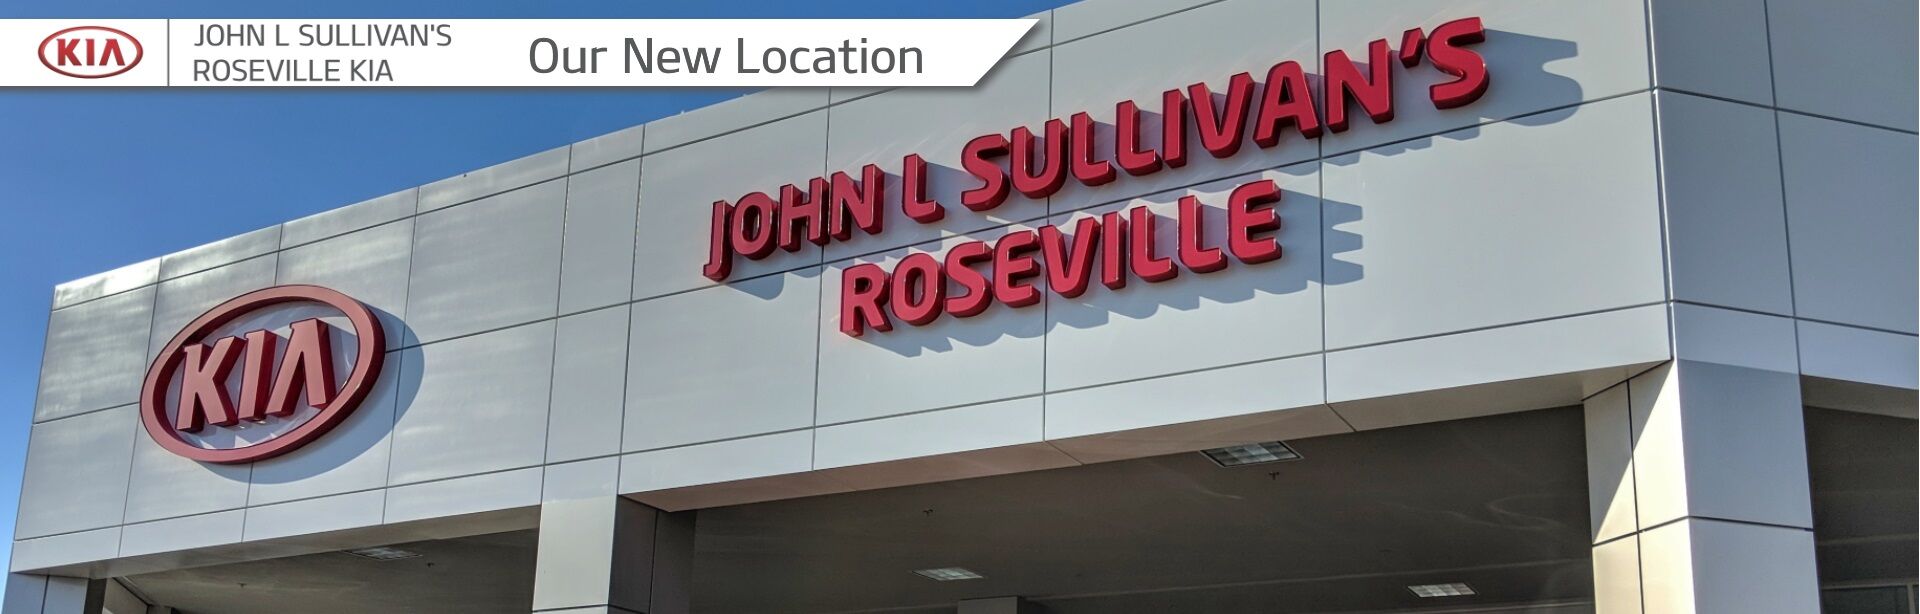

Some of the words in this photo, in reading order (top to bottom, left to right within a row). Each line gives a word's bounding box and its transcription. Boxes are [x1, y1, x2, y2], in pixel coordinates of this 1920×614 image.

[703, 163, 886, 282] JOHN
[902, 153, 945, 224] L
[961, 16, 1490, 212] SULLIVAN'S
[839, 179, 1282, 337] ROSEVILLE
[175, 317, 337, 433] KIA
